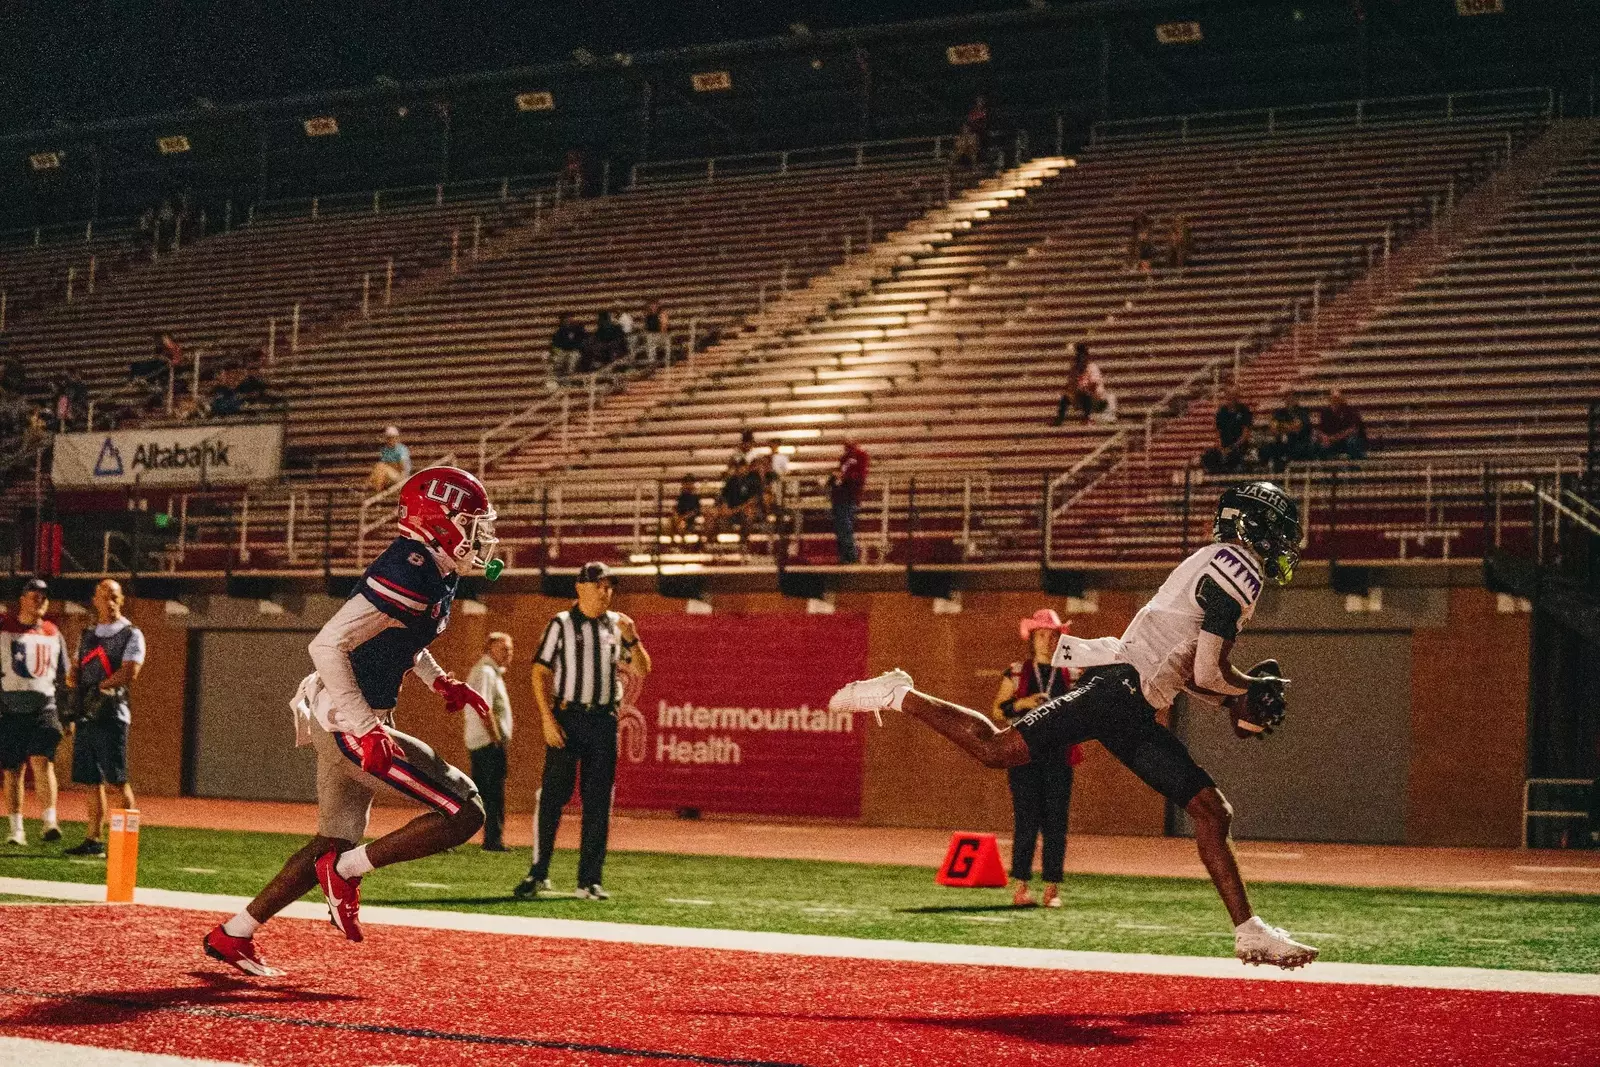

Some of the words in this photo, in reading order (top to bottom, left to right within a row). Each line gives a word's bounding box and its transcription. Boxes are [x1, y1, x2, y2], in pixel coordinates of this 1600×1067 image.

[132, 440, 229, 470] Altabank
[426, 479, 471, 510] UT
[1237, 485, 1288, 512] JACKS
[658, 700, 853, 732] Intermountain
[656, 734, 740, 764] Health
[947, 838, 980, 878] G
